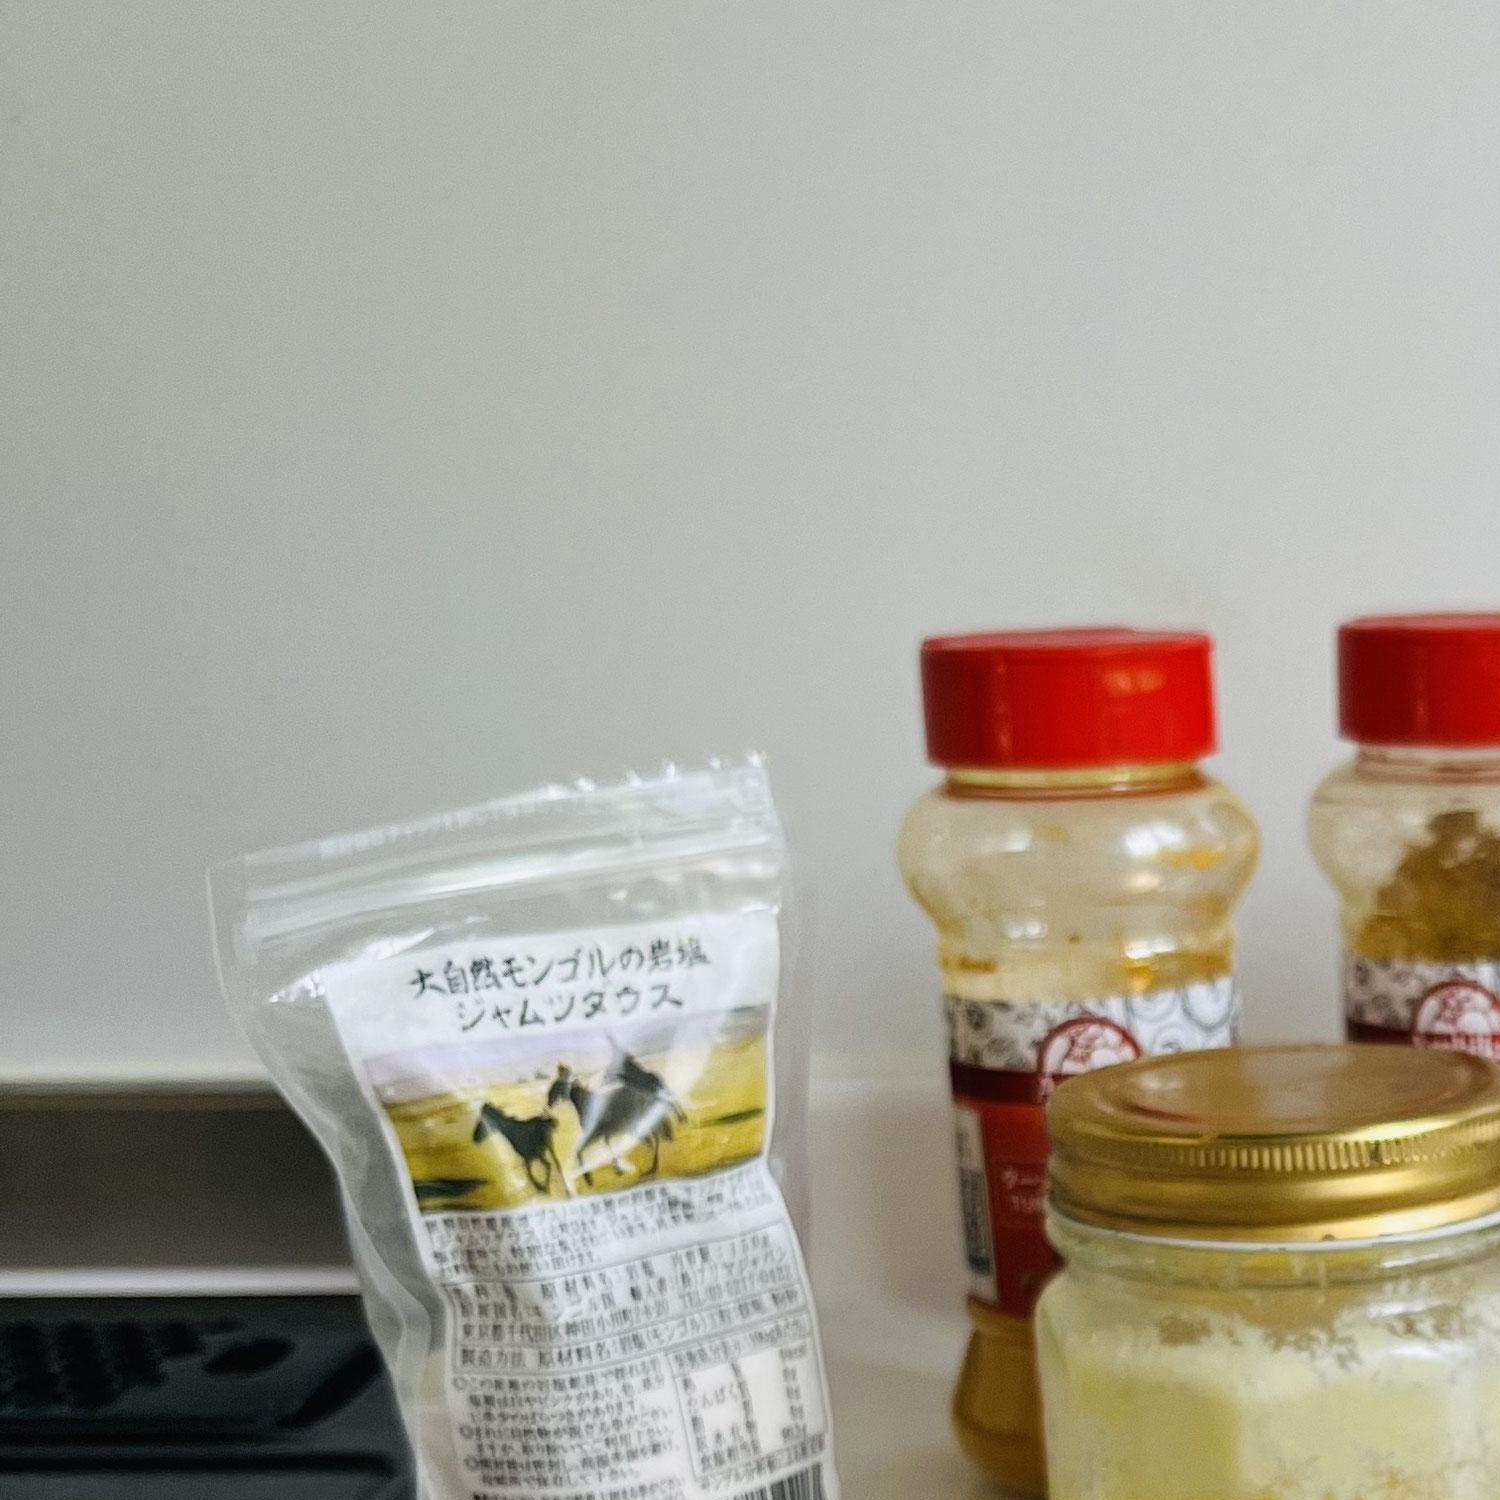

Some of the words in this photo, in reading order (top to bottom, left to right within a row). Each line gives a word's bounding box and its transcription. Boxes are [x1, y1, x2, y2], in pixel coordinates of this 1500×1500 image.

[409, 936, 711, 999] 大自然モンゴルの岩塩
